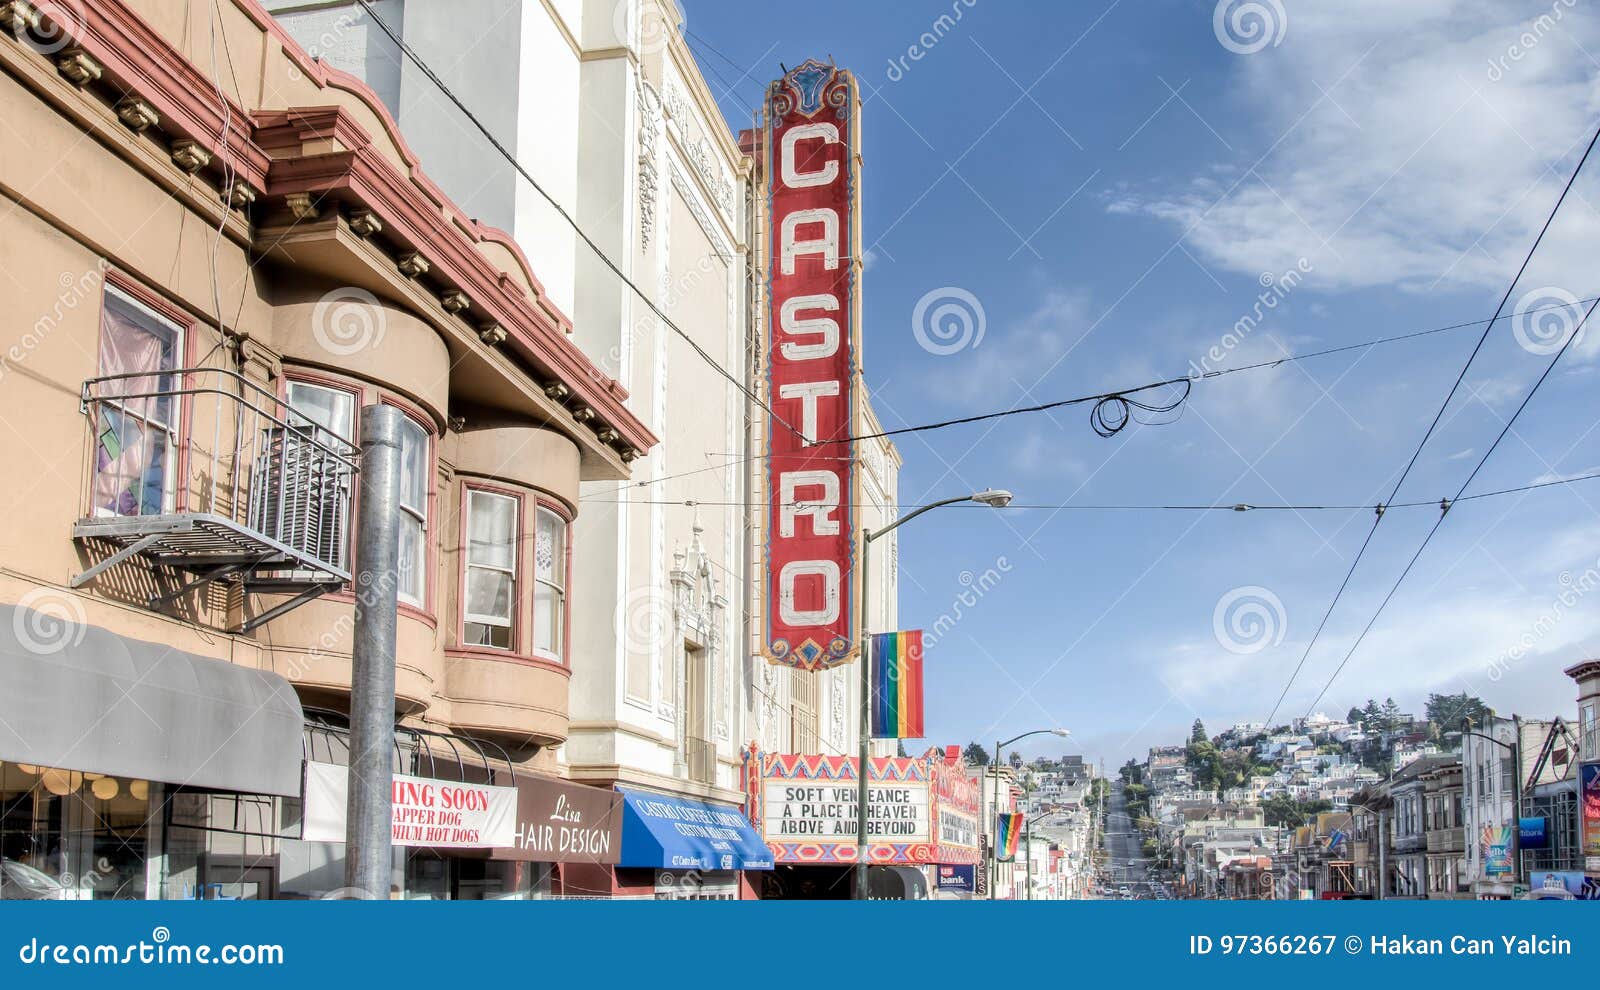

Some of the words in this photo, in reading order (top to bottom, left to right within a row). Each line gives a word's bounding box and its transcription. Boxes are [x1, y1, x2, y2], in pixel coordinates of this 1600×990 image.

[779, 121, 841, 627] CASTRO
[392, 781, 435, 807] ING
[441, 787, 489, 811] SOON
[786, 788, 824, 801] SOFT
[832, 789, 910, 803] VENEANCE
[392, 808, 435, 825] APPER
[438, 811, 463, 826] DOG
[550, 794, 581, 822] Lisa
[636, 800, 680, 820] CASTRO
[783, 804, 792, 817] A
[802, 804, 843, 818] PLACE
[849, 805, 860, 818] IN
[867, 805, 917, 819] HEAVEN
[392, 825, 423, 841] MIUM
[426, 827, 451, 842] HOT
[452, 829, 480, 843] DOGS
[781, 820, 824, 834] ABOVE
[834, 821, 858, 834] AND
[867, 821, 916, 835] BEYOND
[514, 822, 553, 852] HAIR
[560, 827, 610, 854] DESIGN
[941, 876, 965, 884] bank
